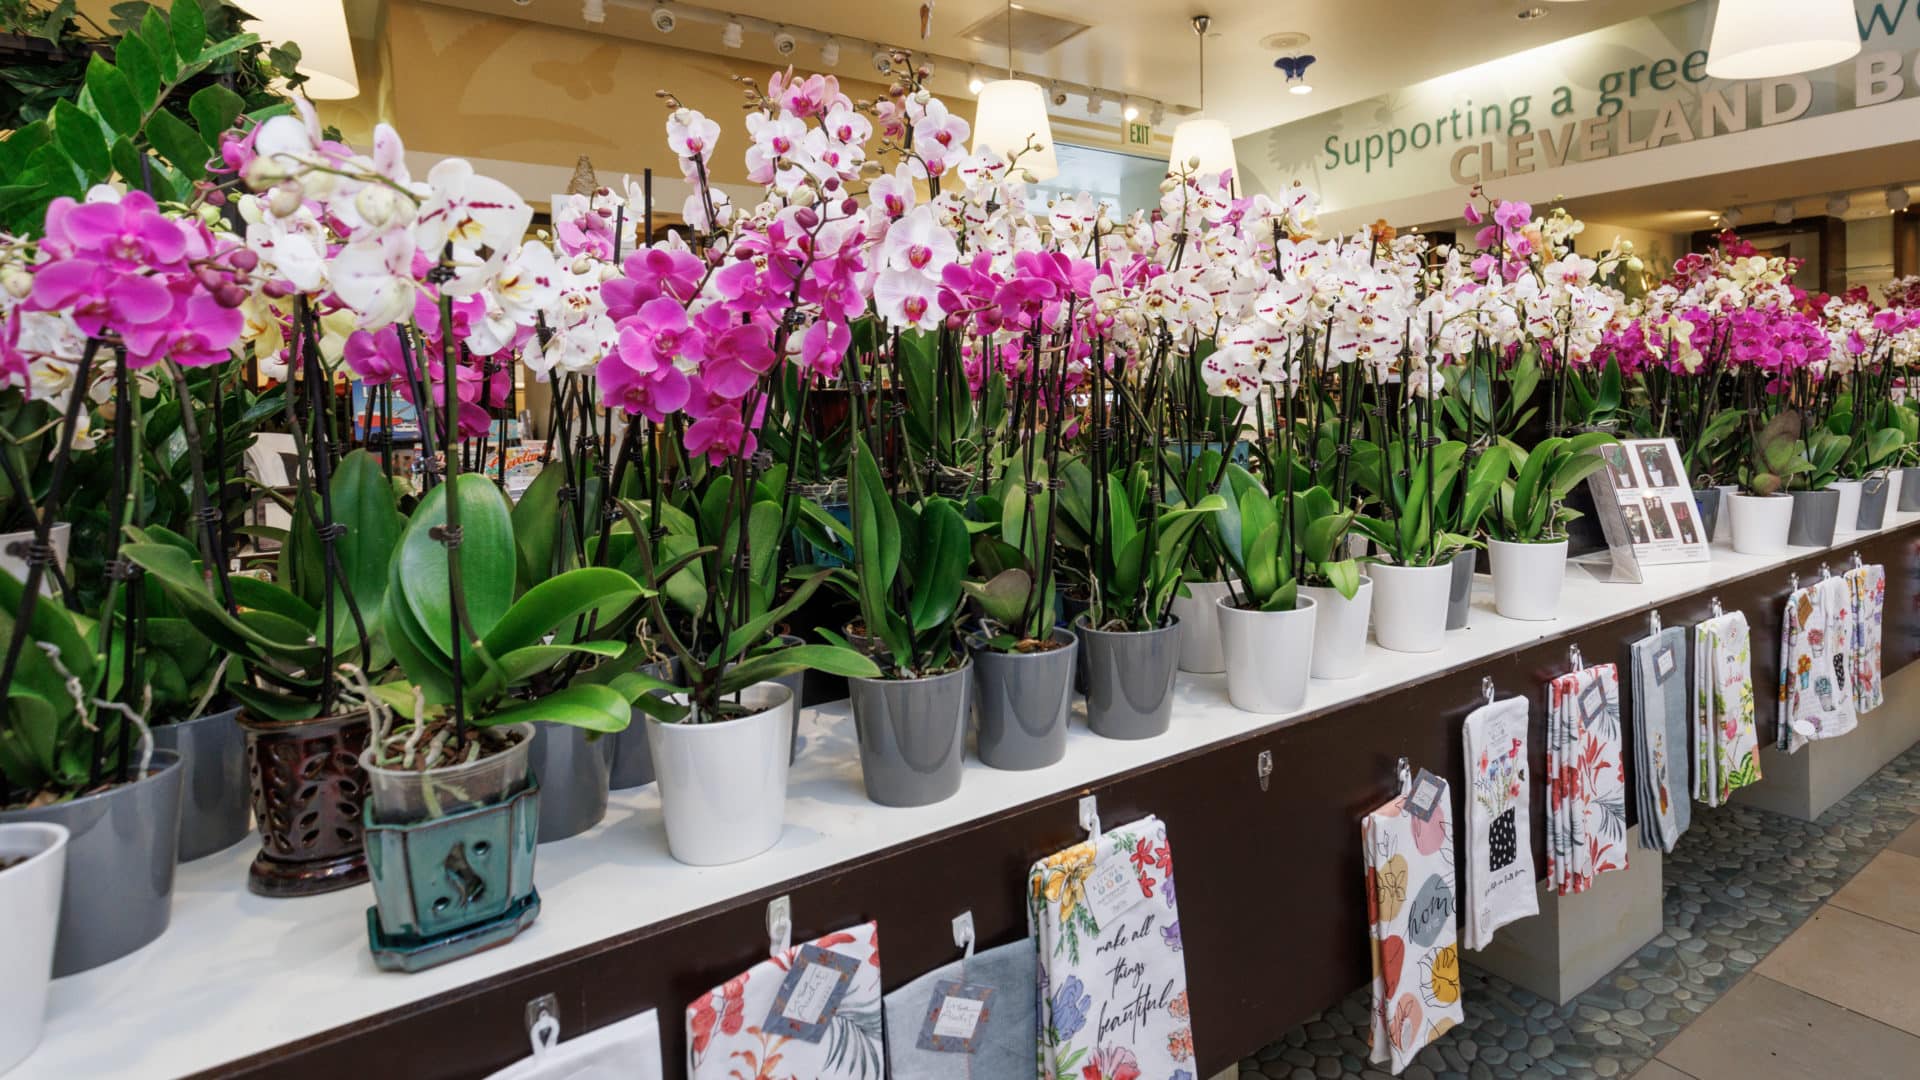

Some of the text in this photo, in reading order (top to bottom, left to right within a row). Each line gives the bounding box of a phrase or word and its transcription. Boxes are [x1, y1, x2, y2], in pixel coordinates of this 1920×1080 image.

[1129, 123, 1150, 145] EXIT
[1325, 96, 1532, 173] Supporting
[1551, 85, 1574, 117] a
[1596, 49, 1709, 118] gree
[1450, 74, 1814, 185] CLEVELAND
[1096, 914, 1155, 956] make all
[1105, 956, 1145, 1000] things
[1097, 978, 1175, 1049] beautiful
